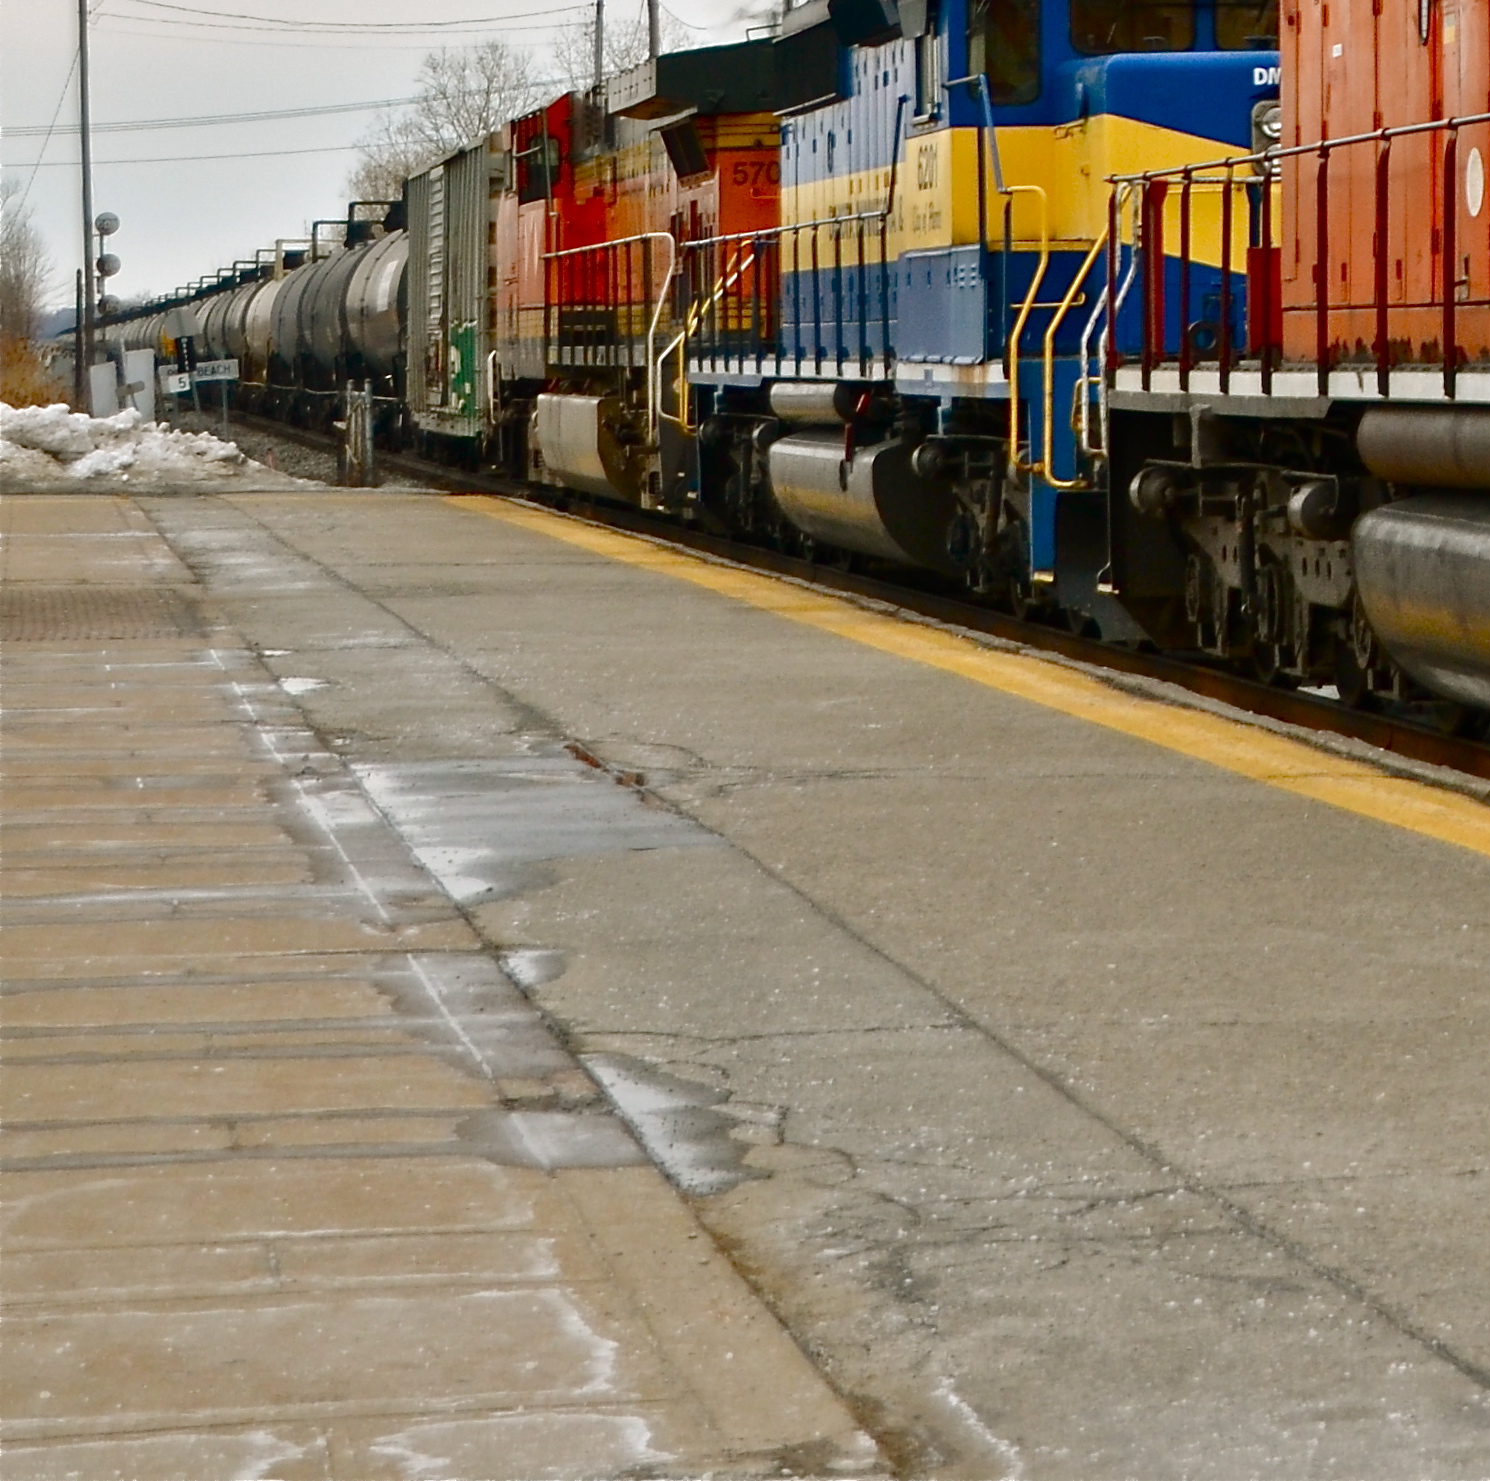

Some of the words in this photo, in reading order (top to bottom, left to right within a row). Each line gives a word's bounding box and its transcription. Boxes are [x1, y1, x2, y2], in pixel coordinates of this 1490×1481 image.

[917, 141, 939, 191] 6201
[197, 364, 231, 377] BEACH
[178, 376, 187, 389] 5
